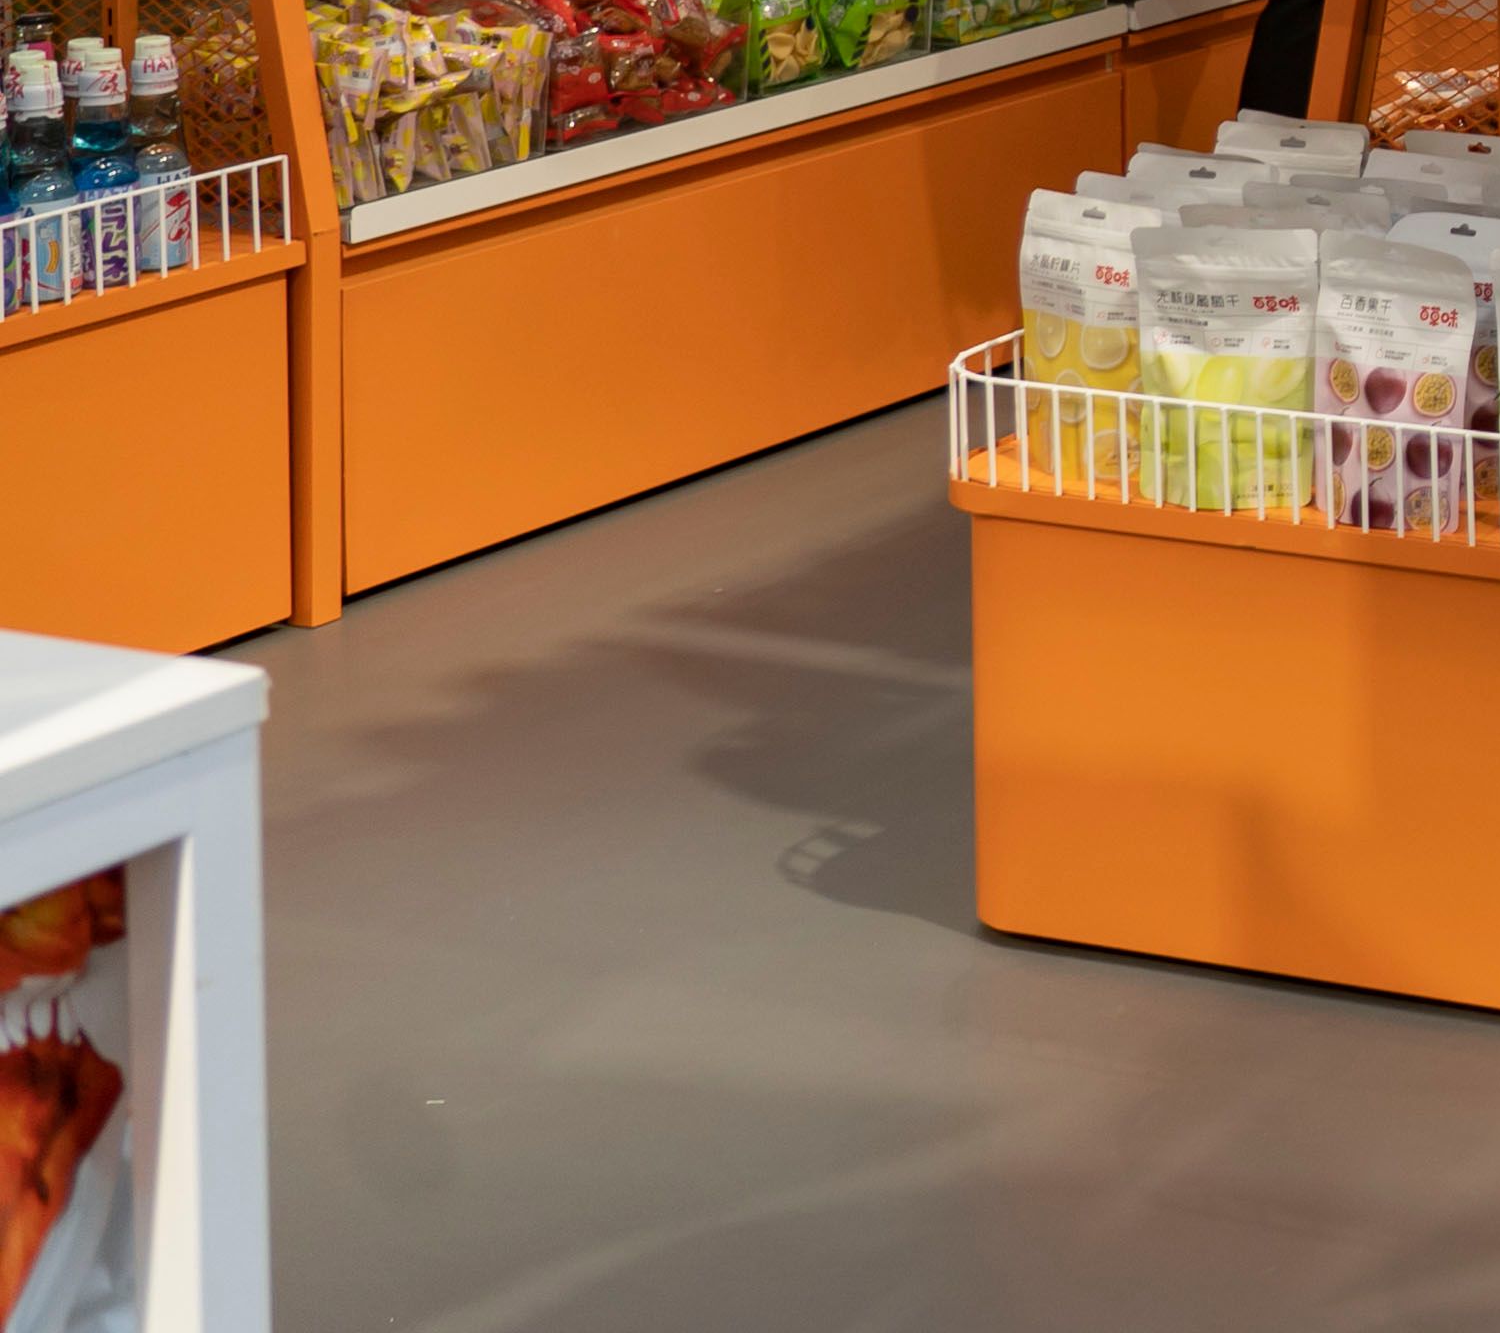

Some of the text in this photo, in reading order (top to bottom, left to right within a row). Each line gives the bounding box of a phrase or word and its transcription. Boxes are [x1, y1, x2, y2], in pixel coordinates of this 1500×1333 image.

[1095, 265, 1130, 287] 百草味
[1253, 295, 1300, 312] 百草味
[1340, 294, 1393, 312] 百香果干
[1420, 306, 1459, 328] 百草味
